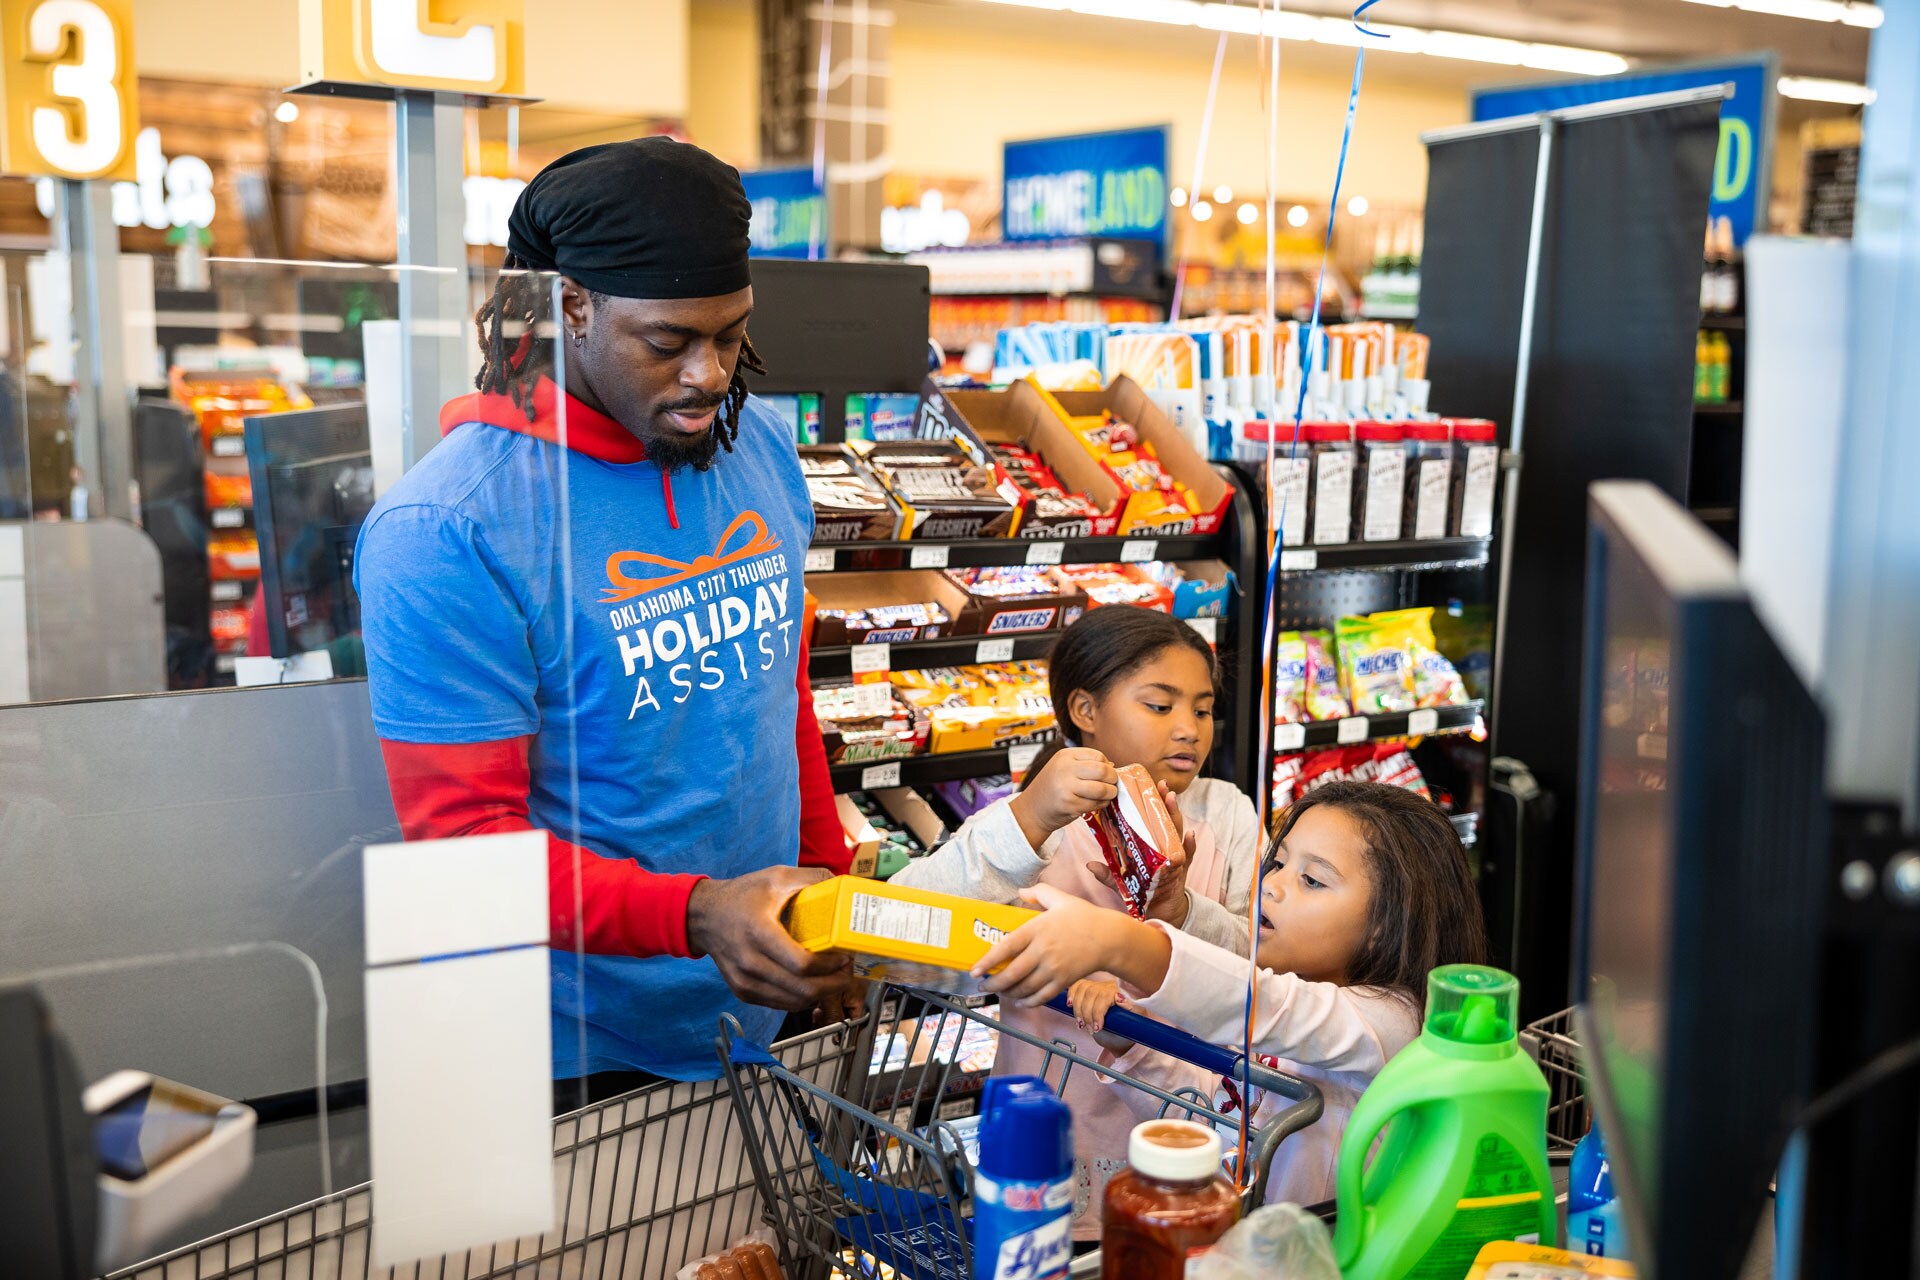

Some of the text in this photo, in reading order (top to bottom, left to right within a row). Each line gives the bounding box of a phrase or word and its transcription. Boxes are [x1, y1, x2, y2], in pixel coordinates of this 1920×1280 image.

[29, 0, 121, 173] 3
[750, 196, 829, 250] ELAND
[1007, 167, 1164, 237] HOMELAND
[813, 522, 863, 541] RSHEY'S
[609, 553, 788, 631] OKLAHOMA CITY THUNDER
[616, 577, 789, 677] HOLIDAY
[867, 628, 914, 642] SNICKERS
[991, 611, 1052, 631] SNICKERS
[628, 619, 794, 720] ASSIST
[845, 739, 915, 762] Milky Way
[1127, 841, 1150, 880] JUMBO
